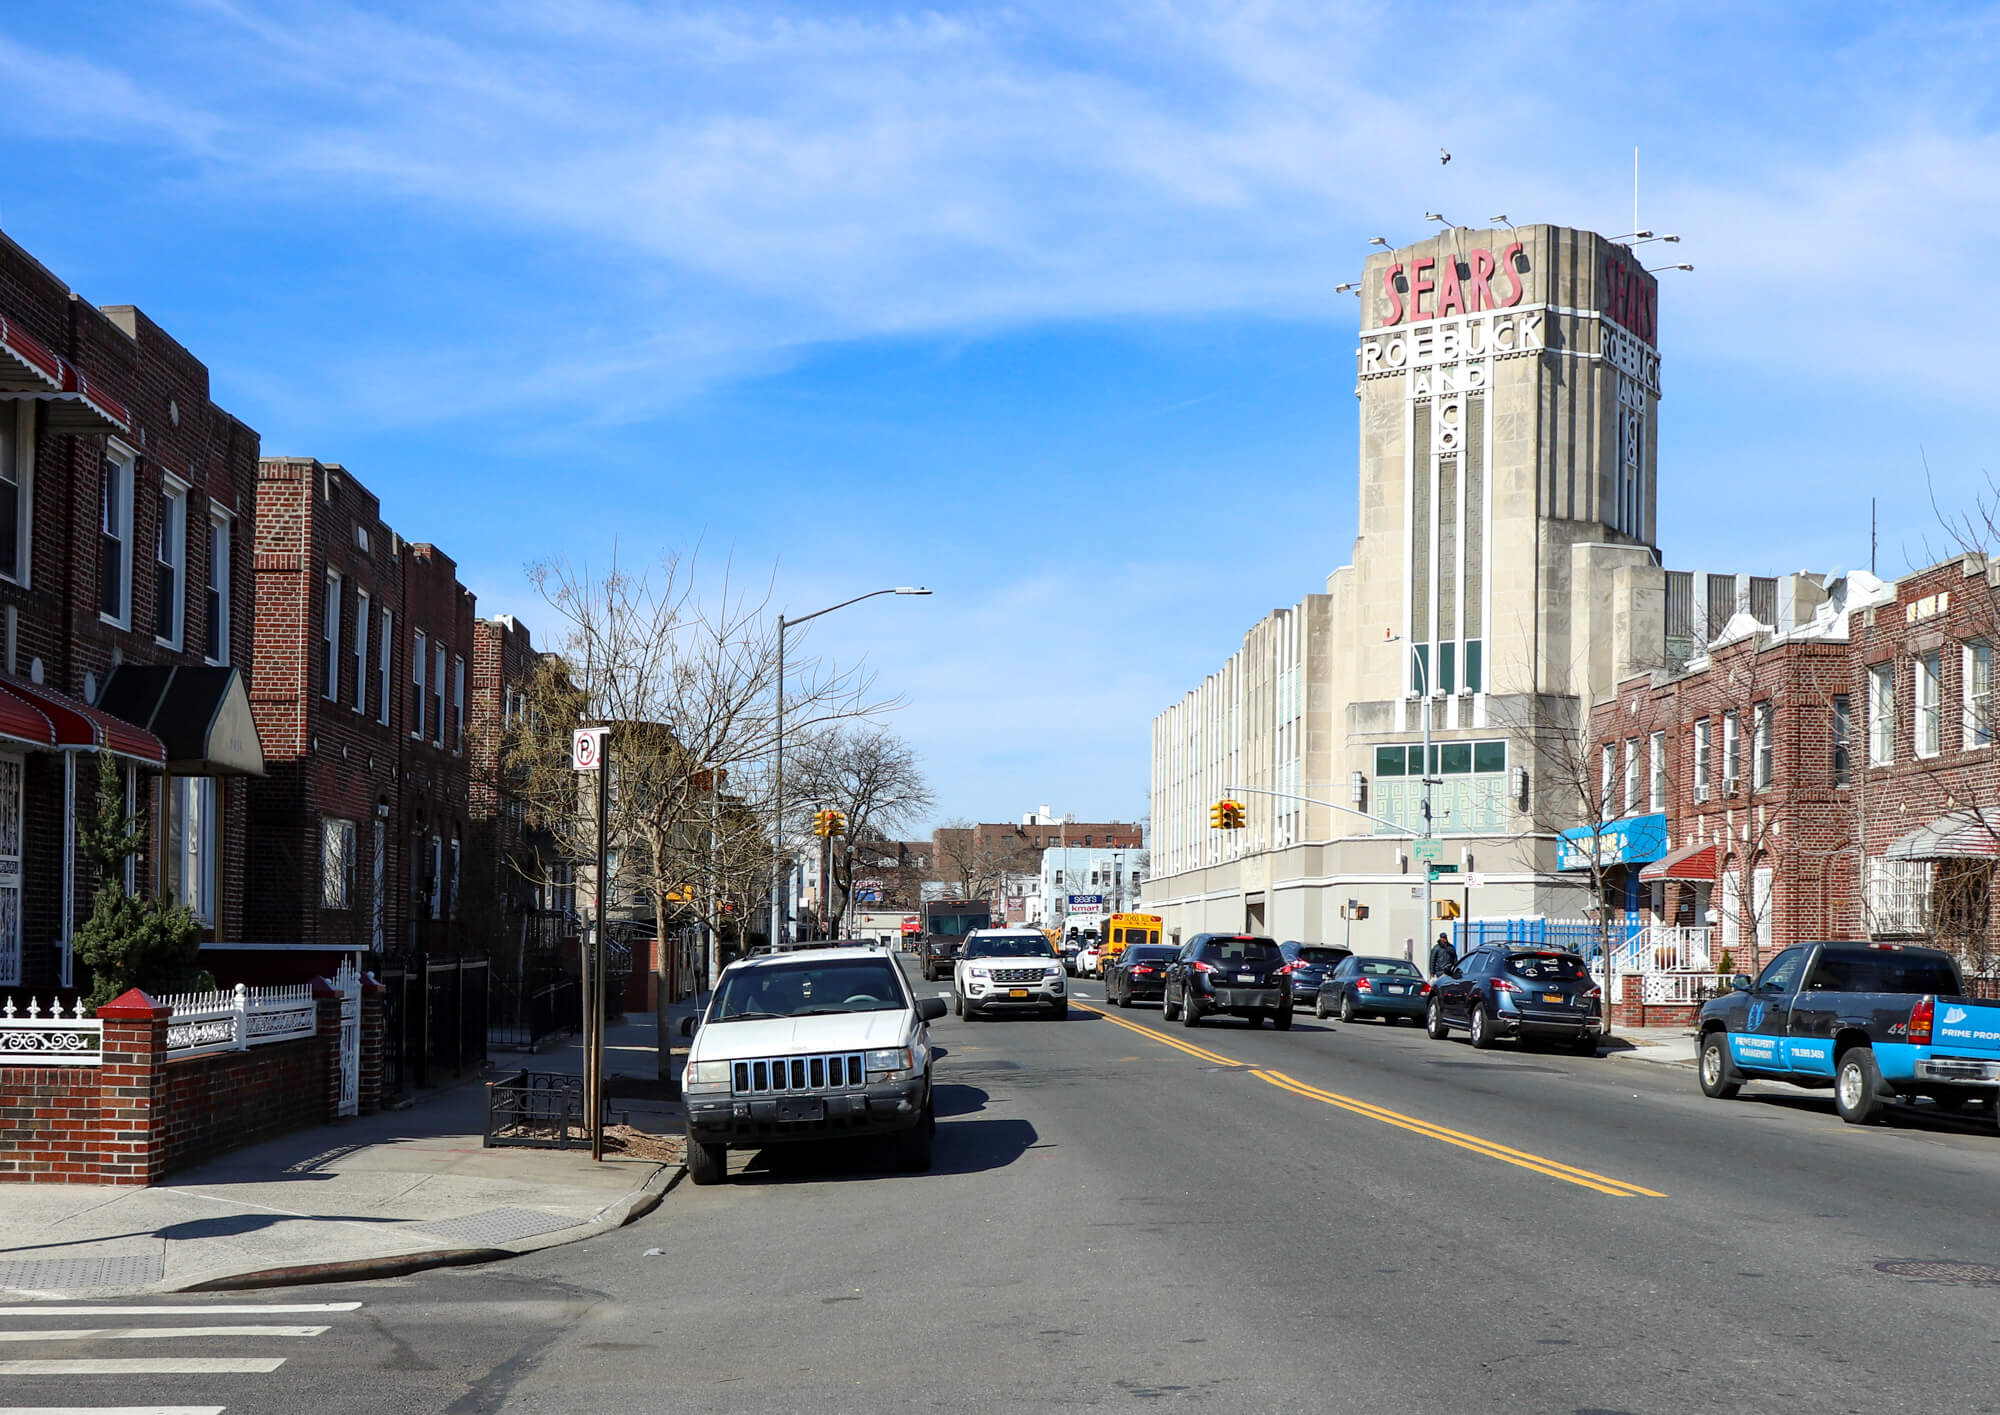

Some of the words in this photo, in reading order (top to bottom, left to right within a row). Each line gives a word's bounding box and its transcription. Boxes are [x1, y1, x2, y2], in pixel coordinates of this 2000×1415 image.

[1382, 242, 1523, 326] SEARS
[1607, 256, 1655, 343] SEARS
[1361, 316, 1543, 374] ROEBUCK
[1601, 326, 1661, 393] ROEBUCK
[1414, 367, 1485, 396] AND
[1619, 379, 1645, 411] AND
[1071, 904, 1099, 912] kmart
[1073, 895, 1097, 904] sears
[1942, 1028, 1971, 1038] PRIME
[1973, 1031, 2000, 1040] PROP
